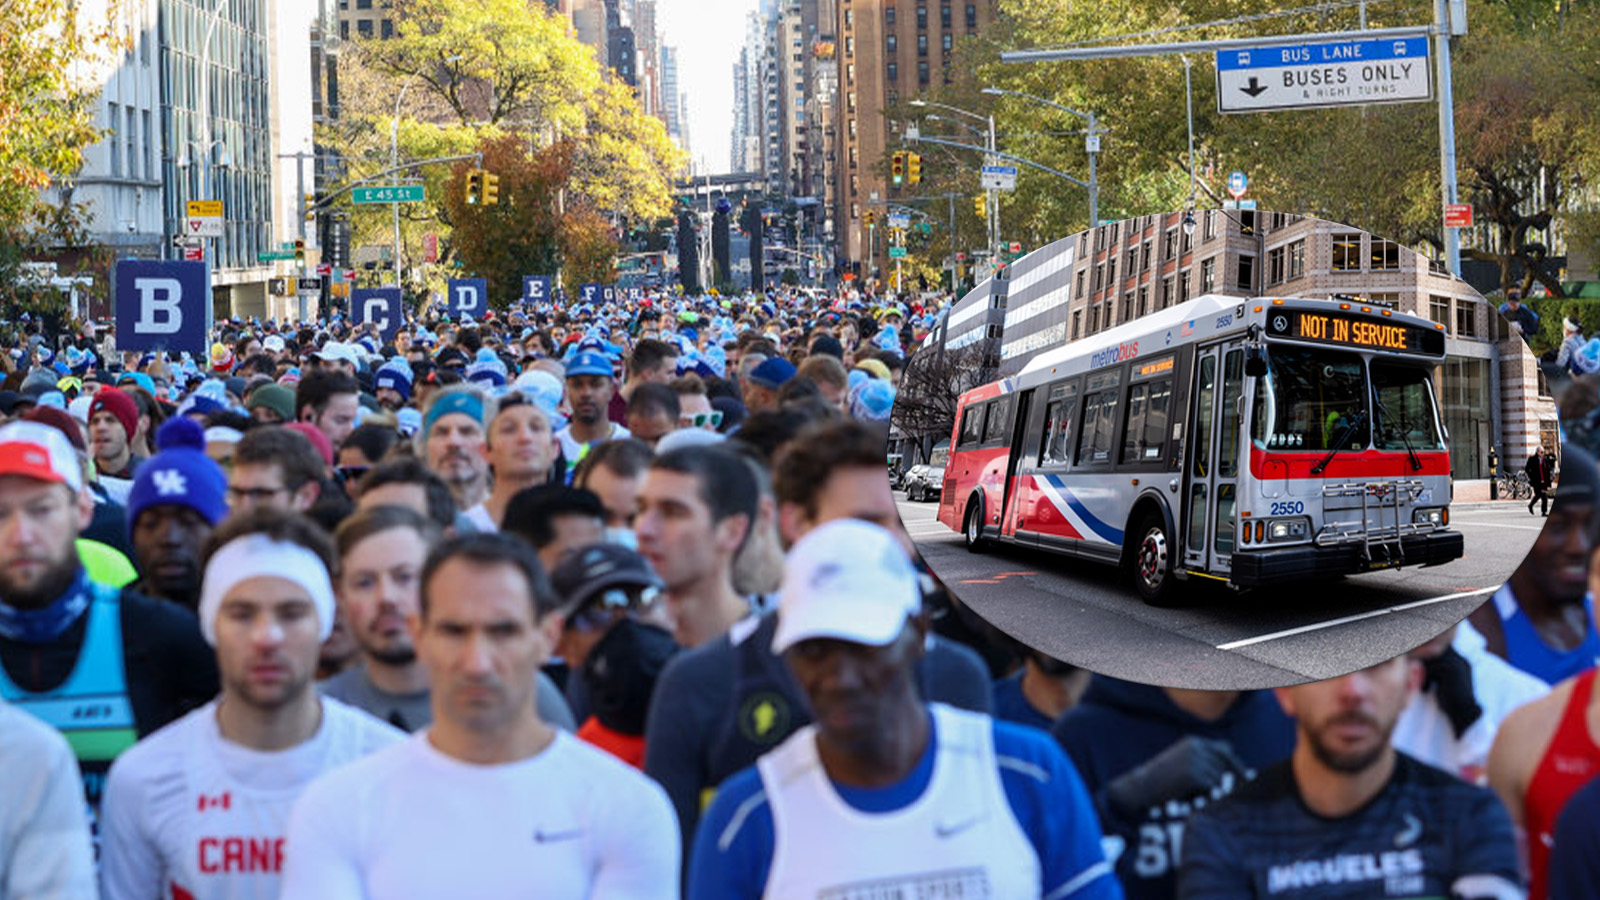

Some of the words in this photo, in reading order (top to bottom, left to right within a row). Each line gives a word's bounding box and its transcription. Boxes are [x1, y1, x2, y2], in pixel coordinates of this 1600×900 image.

[1281, 48, 1310, 63] BUS
[1323, 44, 1363, 60] LANE
[1283, 68, 1347, 88] BUSES
[1362, 63, 1413, 82] ONLY
[1316, 86, 1351, 97] RIGHT
[1358, 84, 1397, 96] TURNS
[365, 190, 373, 200] E
[376, 189, 393, 200] 45
[397, 188, 411, 199] St
[455, 286, 478, 311] D
[528, 280, 544, 298] E
[584, 286, 596, 301] F
[134, 277, 183, 335] B
[363, 298, 389, 332] C
[1300, 313, 1328, 339] NOT
[1333, 318, 1349, 342] IN
[1352, 321, 1408, 349] SERVICE
[1090, 341, 1139, 370] metrobus
[1270, 501, 1305, 516] 2550
